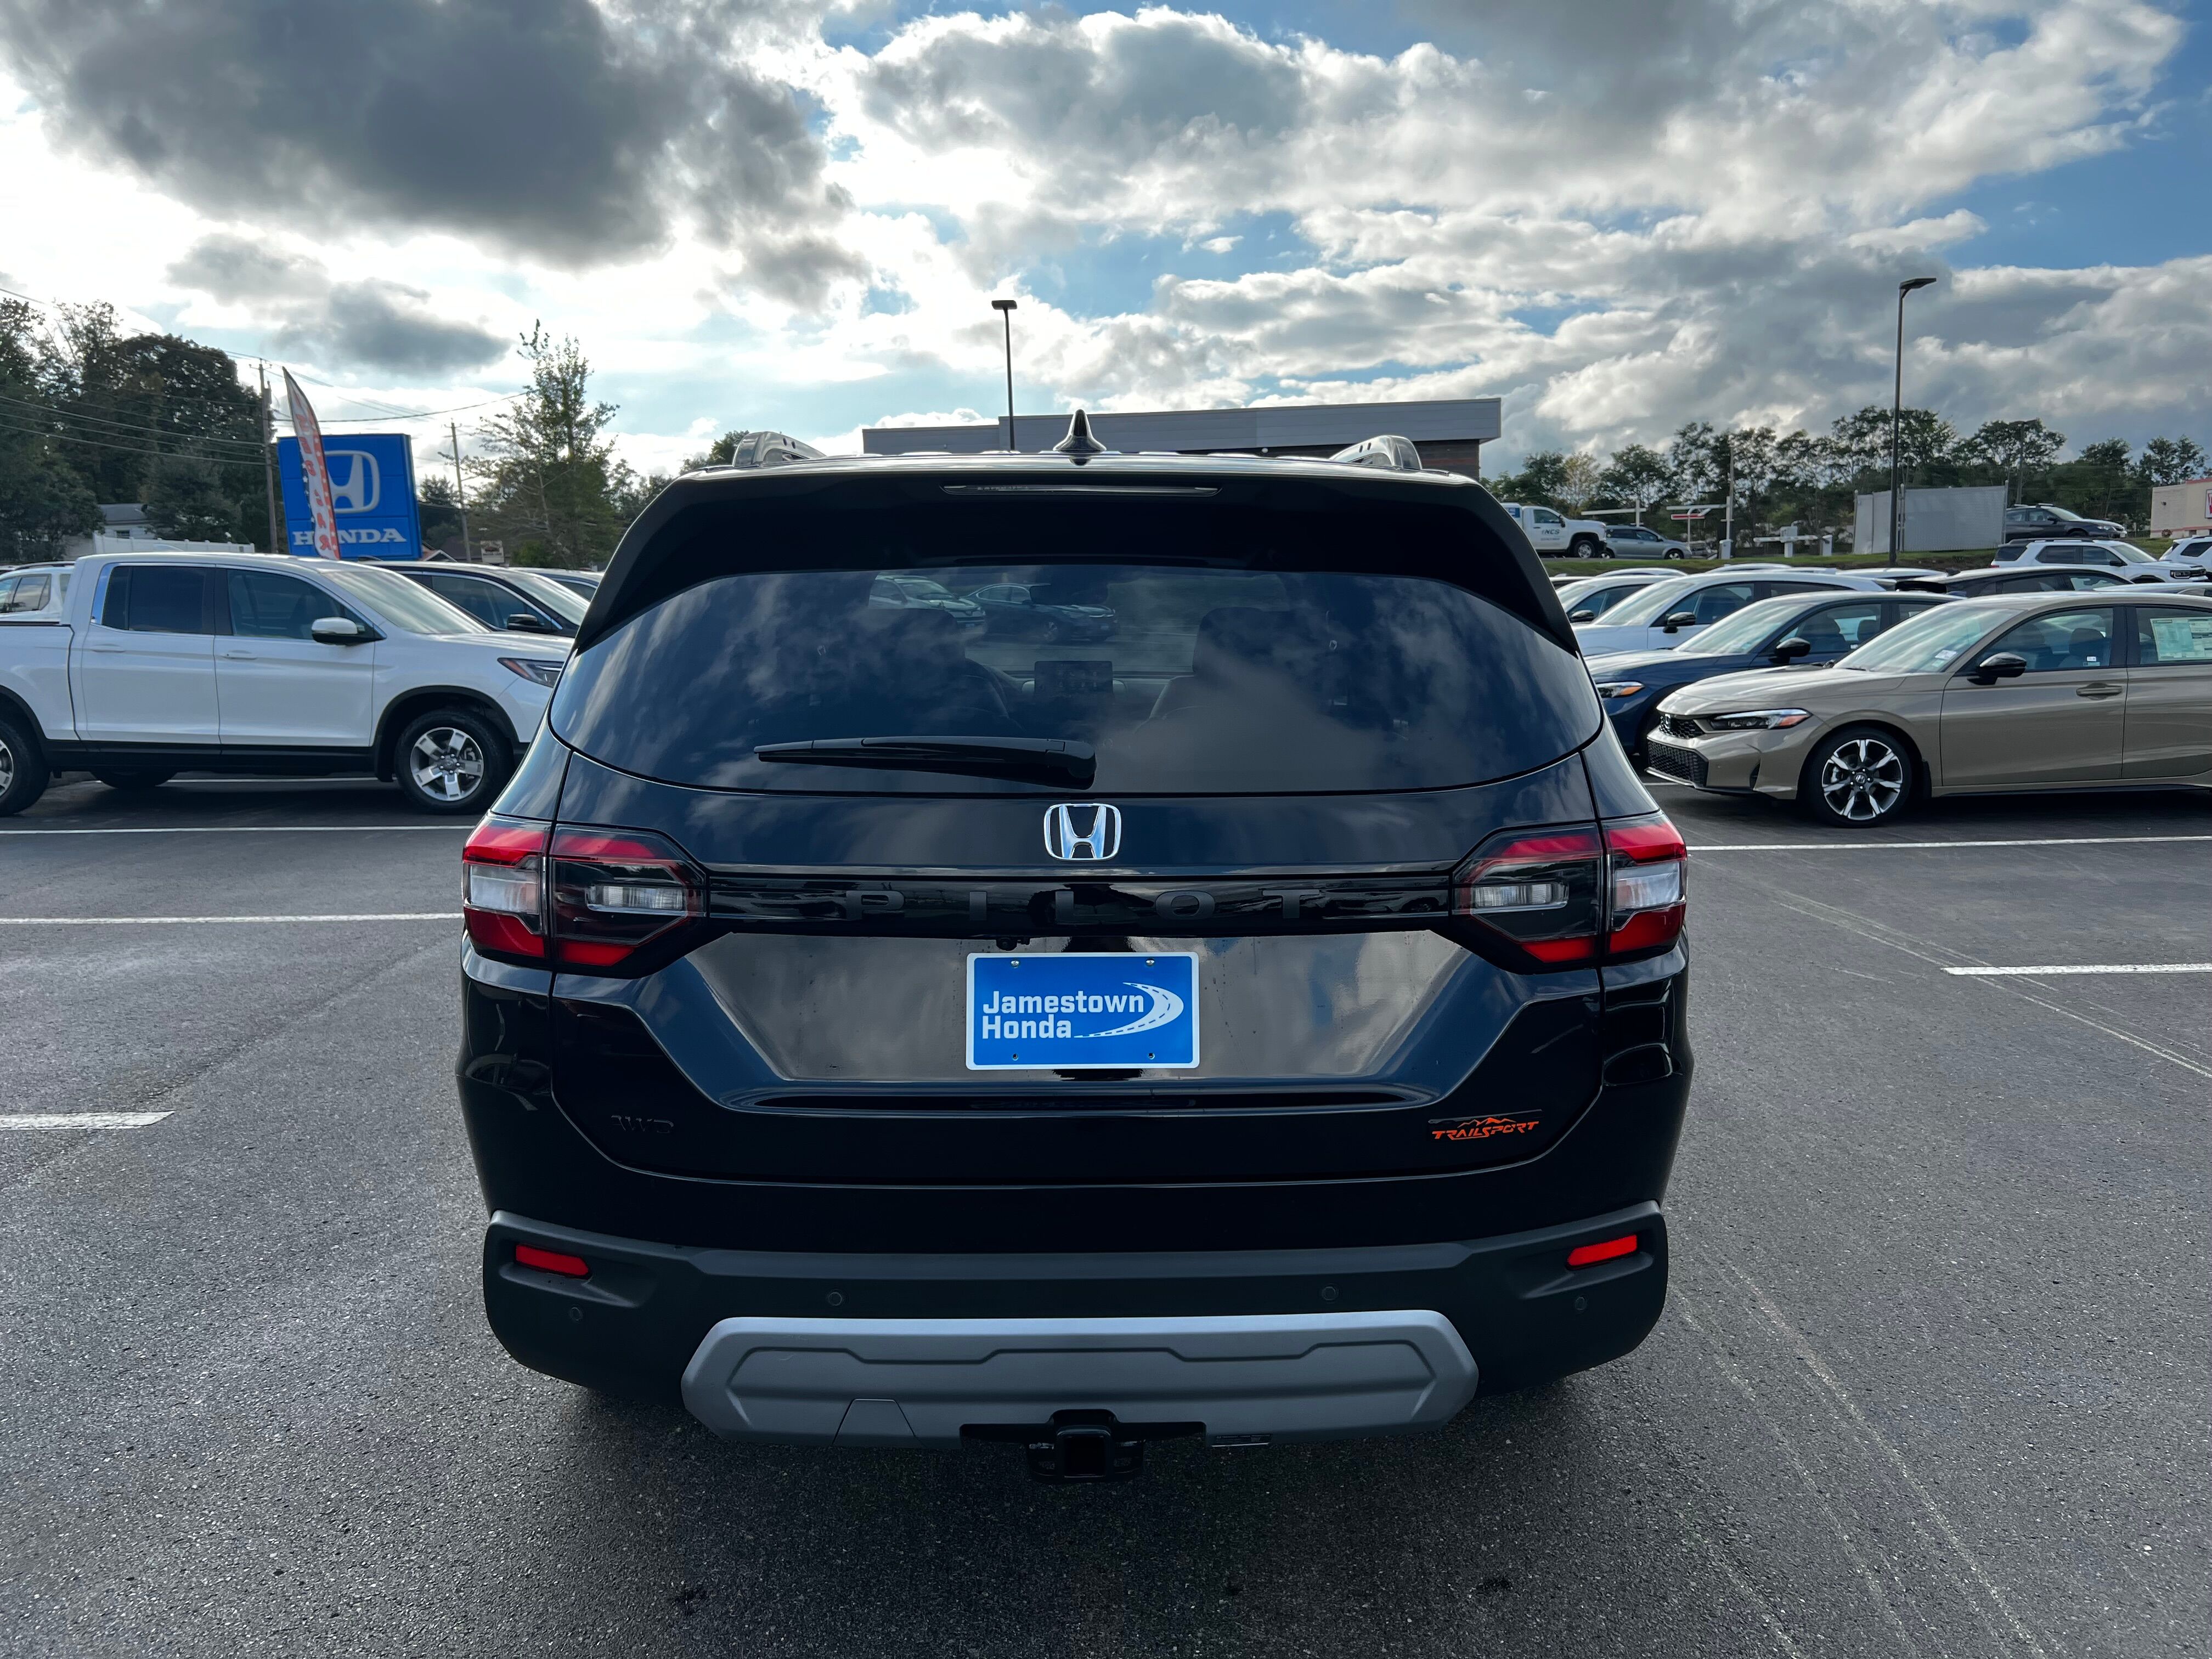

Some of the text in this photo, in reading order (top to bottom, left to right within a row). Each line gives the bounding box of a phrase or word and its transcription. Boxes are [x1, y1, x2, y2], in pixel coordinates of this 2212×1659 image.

[292, 527, 407, 546] HNDA
[844, 888, 1322, 925] PILOT
[982, 990, 1144, 1014] Jamestown
[981, 1014, 1072, 1040] Honda
[1431, 1120, 1540, 1141] TRAILSPORT
